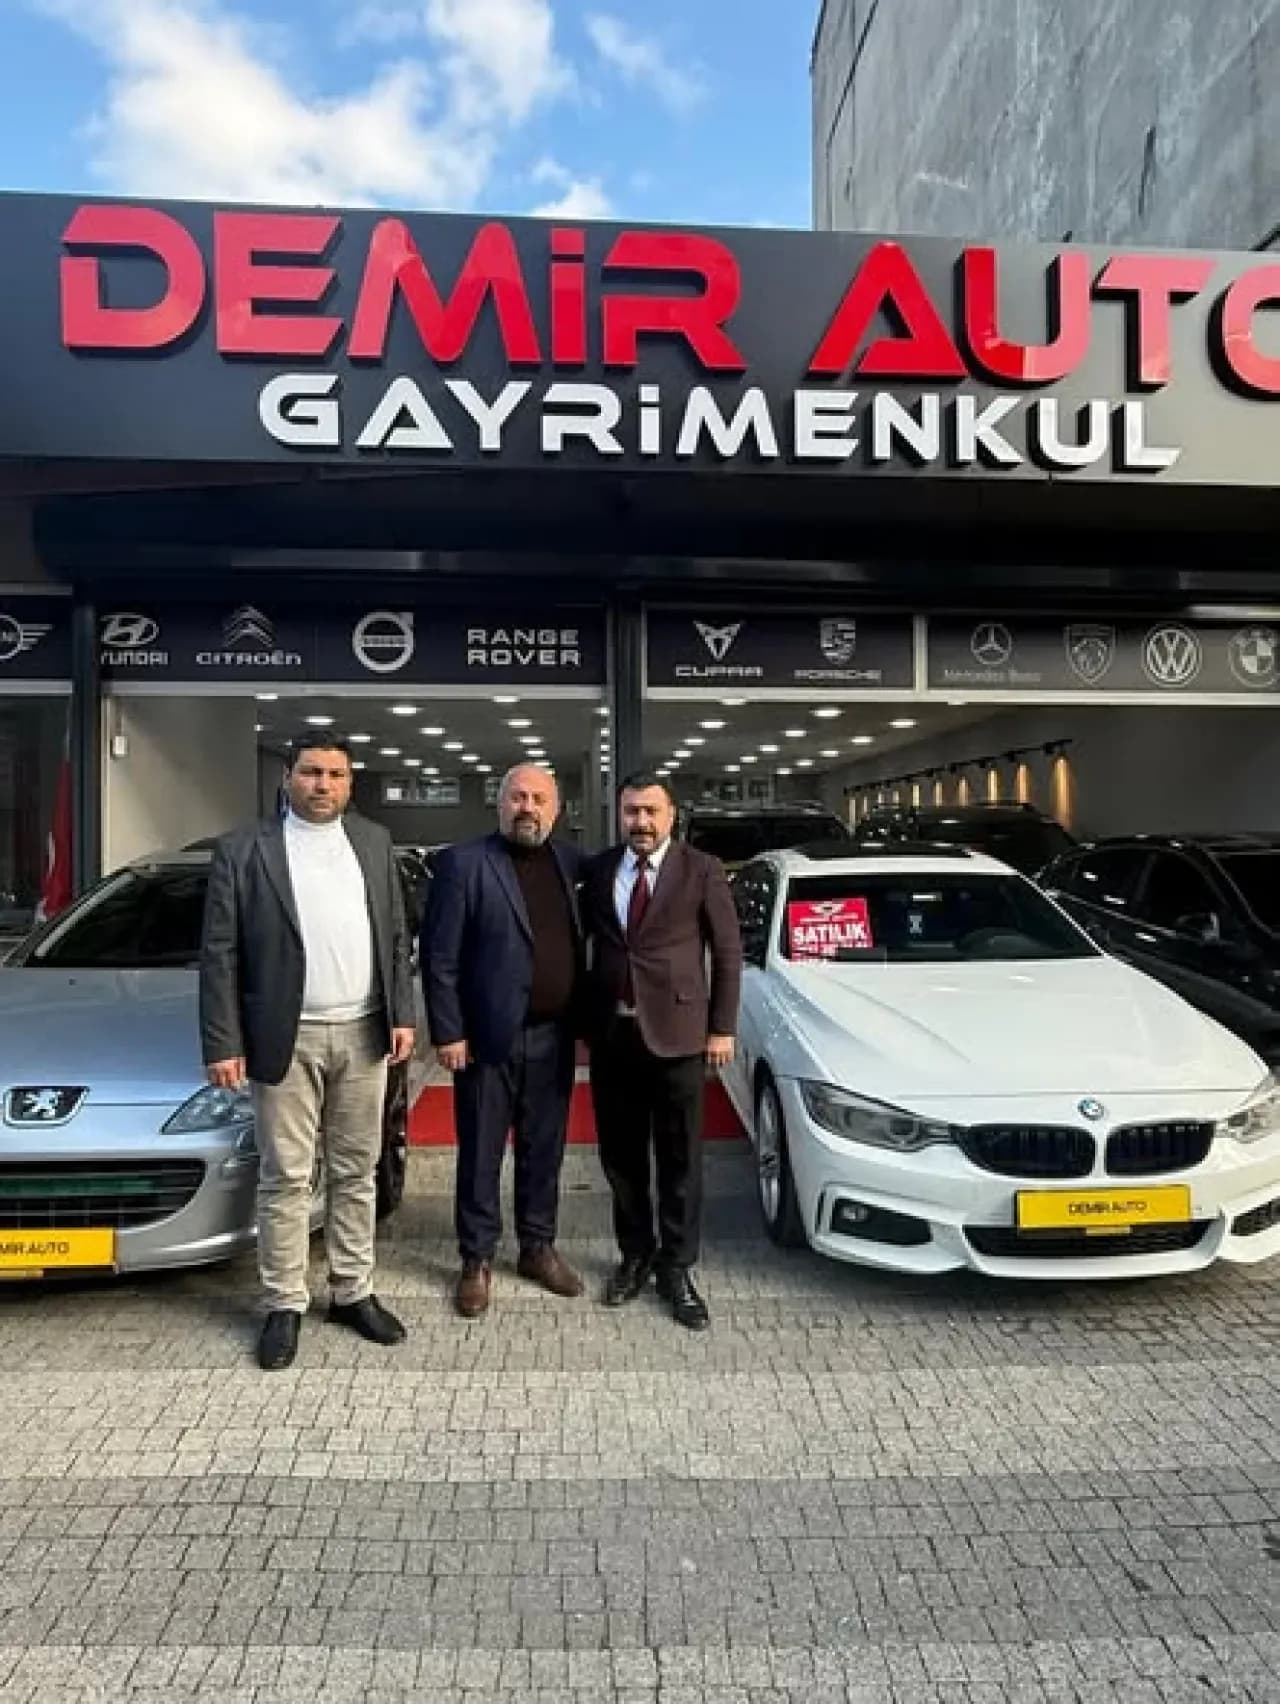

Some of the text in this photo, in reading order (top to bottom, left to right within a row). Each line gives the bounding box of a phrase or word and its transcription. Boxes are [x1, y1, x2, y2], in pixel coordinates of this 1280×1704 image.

[467, 629, 579, 645] RANGE
[101, 652, 168, 665] YUNDAI
[467, 650, 581, 665] ROVER
[675, 666, 763, 677] CUPRA
